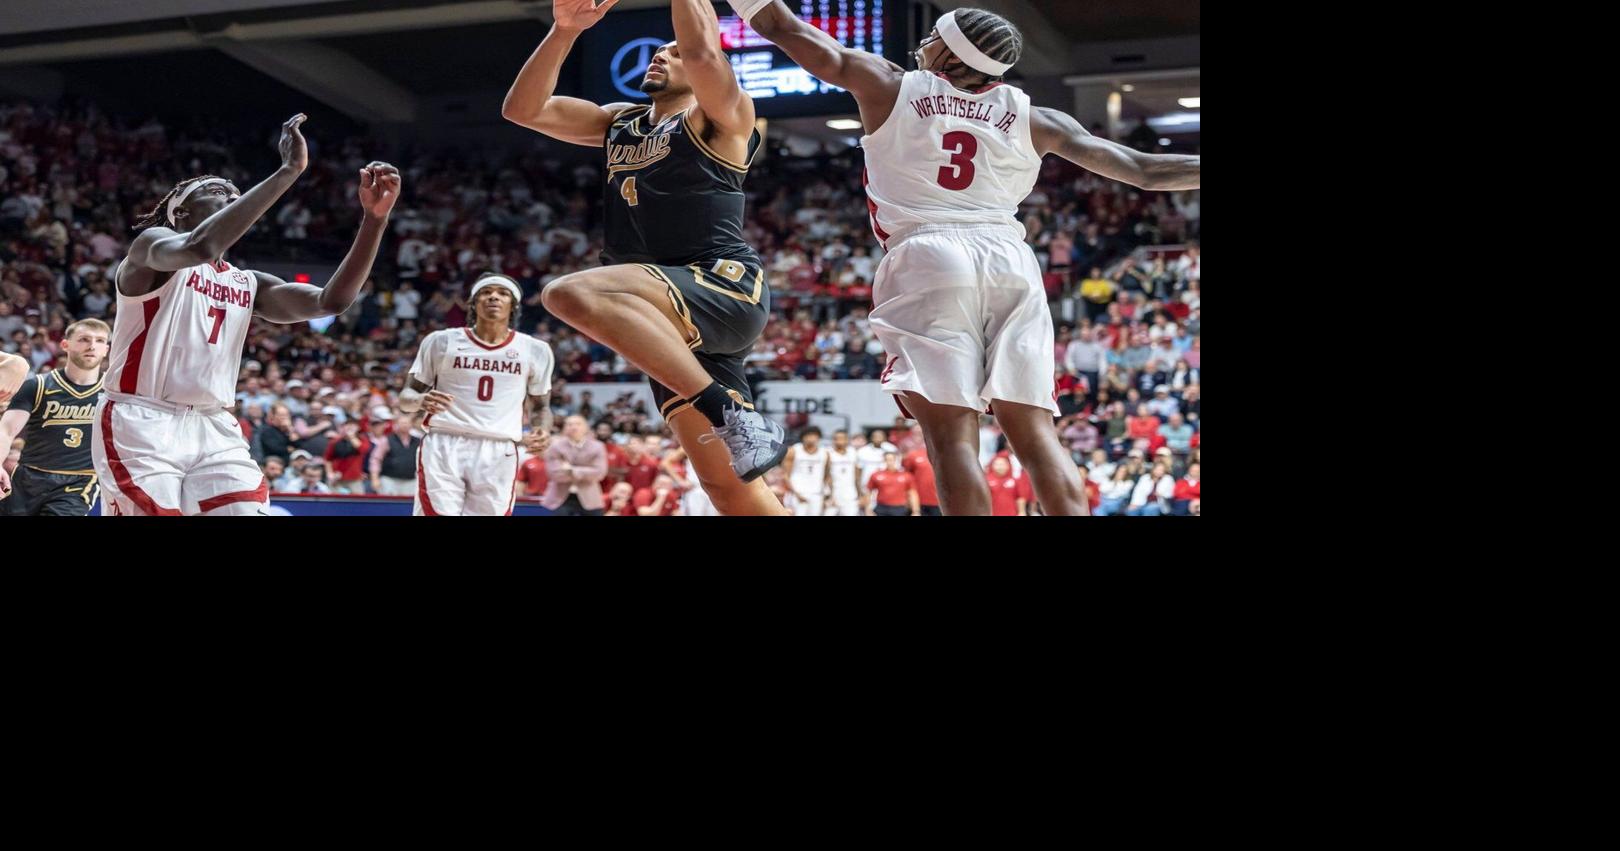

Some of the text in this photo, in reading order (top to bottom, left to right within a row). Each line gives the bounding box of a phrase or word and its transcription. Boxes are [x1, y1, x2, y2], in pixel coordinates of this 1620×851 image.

[910, 95, 1016, 133] WRIGHTSELL JR.
[937, 130, 977, 191] 3
[621, 176, 638, 206] 4
[186, 270, 251, 309] ALABAMA
[207, 305, 227, 344] 7
[453, 356, 521, 375] ALABAMA
[477, 375, 494, 402] 0
[783, 397, 834, 414] TIDE
[63, 427, 84, 448] 3
